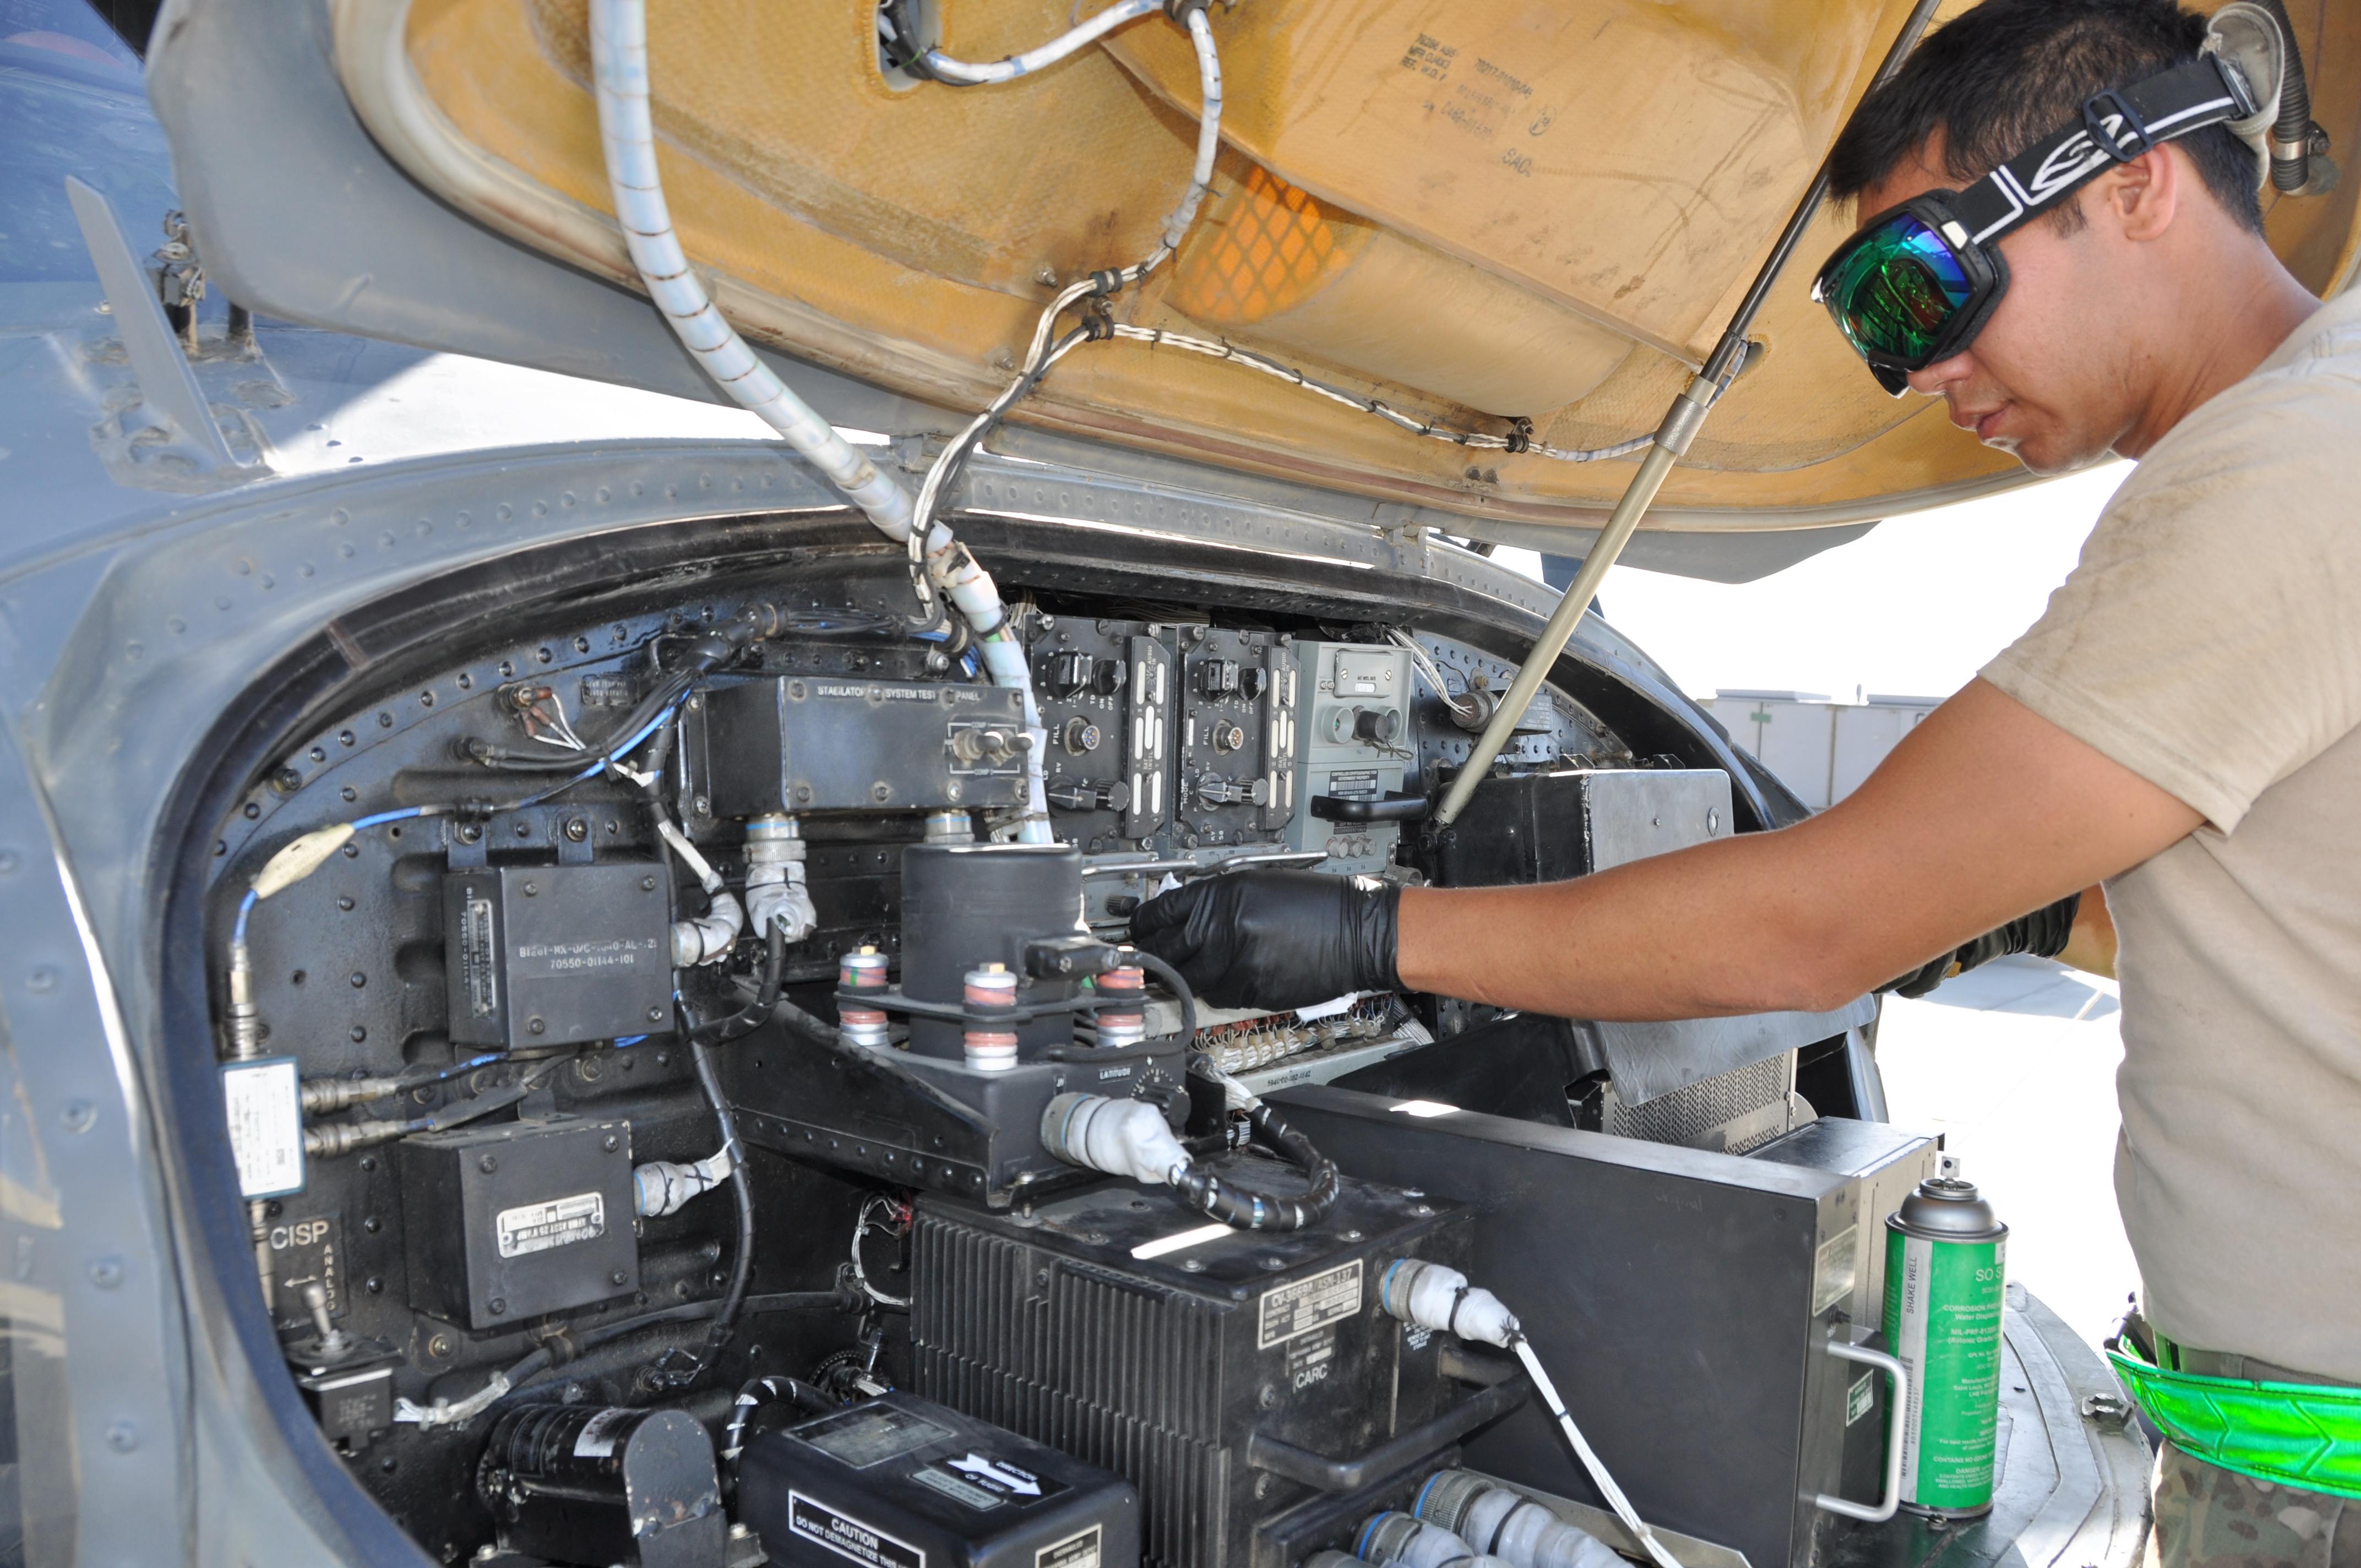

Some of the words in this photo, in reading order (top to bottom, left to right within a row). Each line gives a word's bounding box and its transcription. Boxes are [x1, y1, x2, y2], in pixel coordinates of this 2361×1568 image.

[885, 688, 917, 699] SYSTEM
[917, 689, 935, 700] TEST
[956, 690, 981, 701] PANEL
[1099, 698, 1105, 709] ON
[1242, 703, 1247, 713] ON
[1056, 762, 1062, 773] RV
[1206, 761, 1210, 771] RV
[1195, 769, 1200, 778] LD
[1099, 1066, 1131, 1080] LATITUDE
[270, 1219, 329, 1250] CISP
[1908, 1257, 1917, 1281] WELL
[1976, 1268, 1994, 1282] SO
[1906, 1283, 1915, 1314] SHAKE
[1296, 1363, 1328, 1389] CARC
[995, 1461, 1039, 1482] DIRECTION
[978, 1479, 1005, 1493] FLIGHT
[796, 1515, 808, 1529] DO
[808, 1521, 825, 1536] NOT
[825, 1529, 879, 1562] DEMAGNETIZE
[831, 1518, 879, 1550] CAUTION
